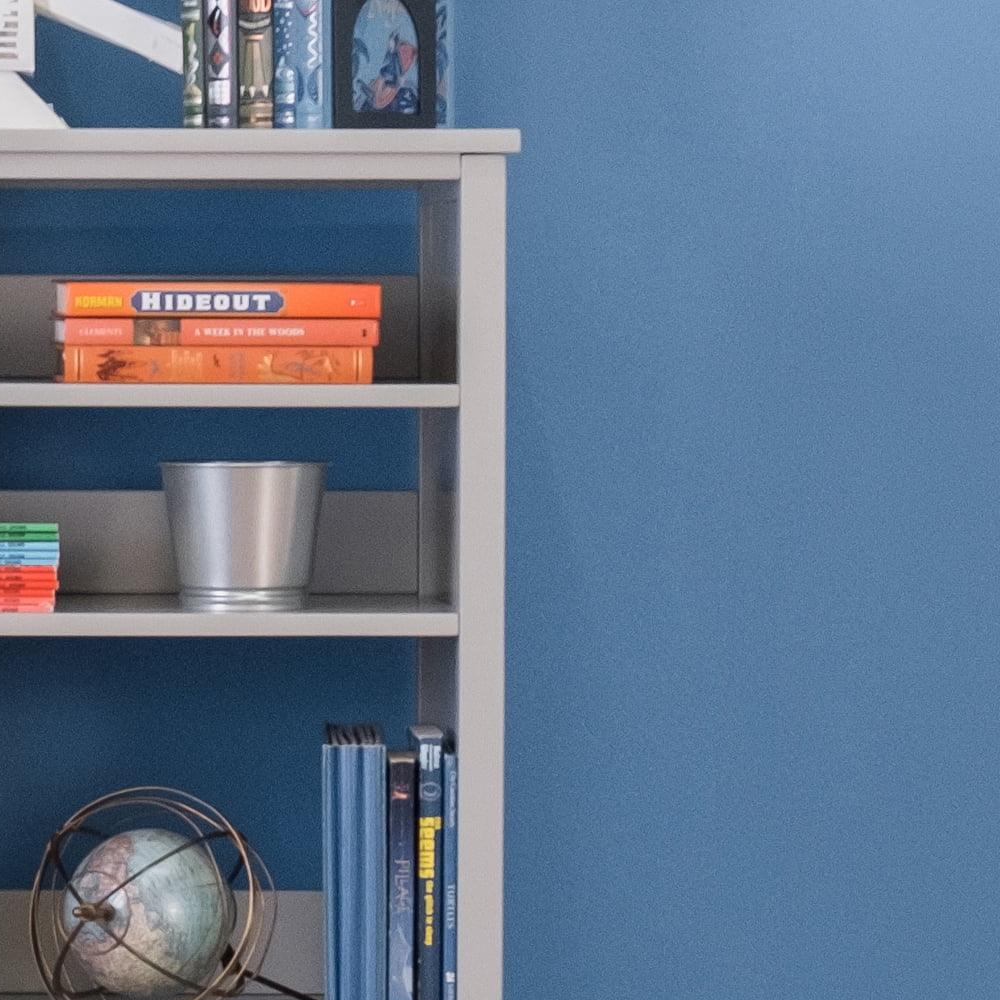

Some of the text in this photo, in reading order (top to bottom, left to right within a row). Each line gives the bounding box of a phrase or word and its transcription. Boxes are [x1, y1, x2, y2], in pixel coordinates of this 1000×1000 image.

[141, 292, 271, 312] HIDEOUT
[204, 328, 230, 337] WEEK
[233, 328, 244, 337] IN
[247, 328, 266, 337] THE
[269, 328, 305, 337] WOODS
